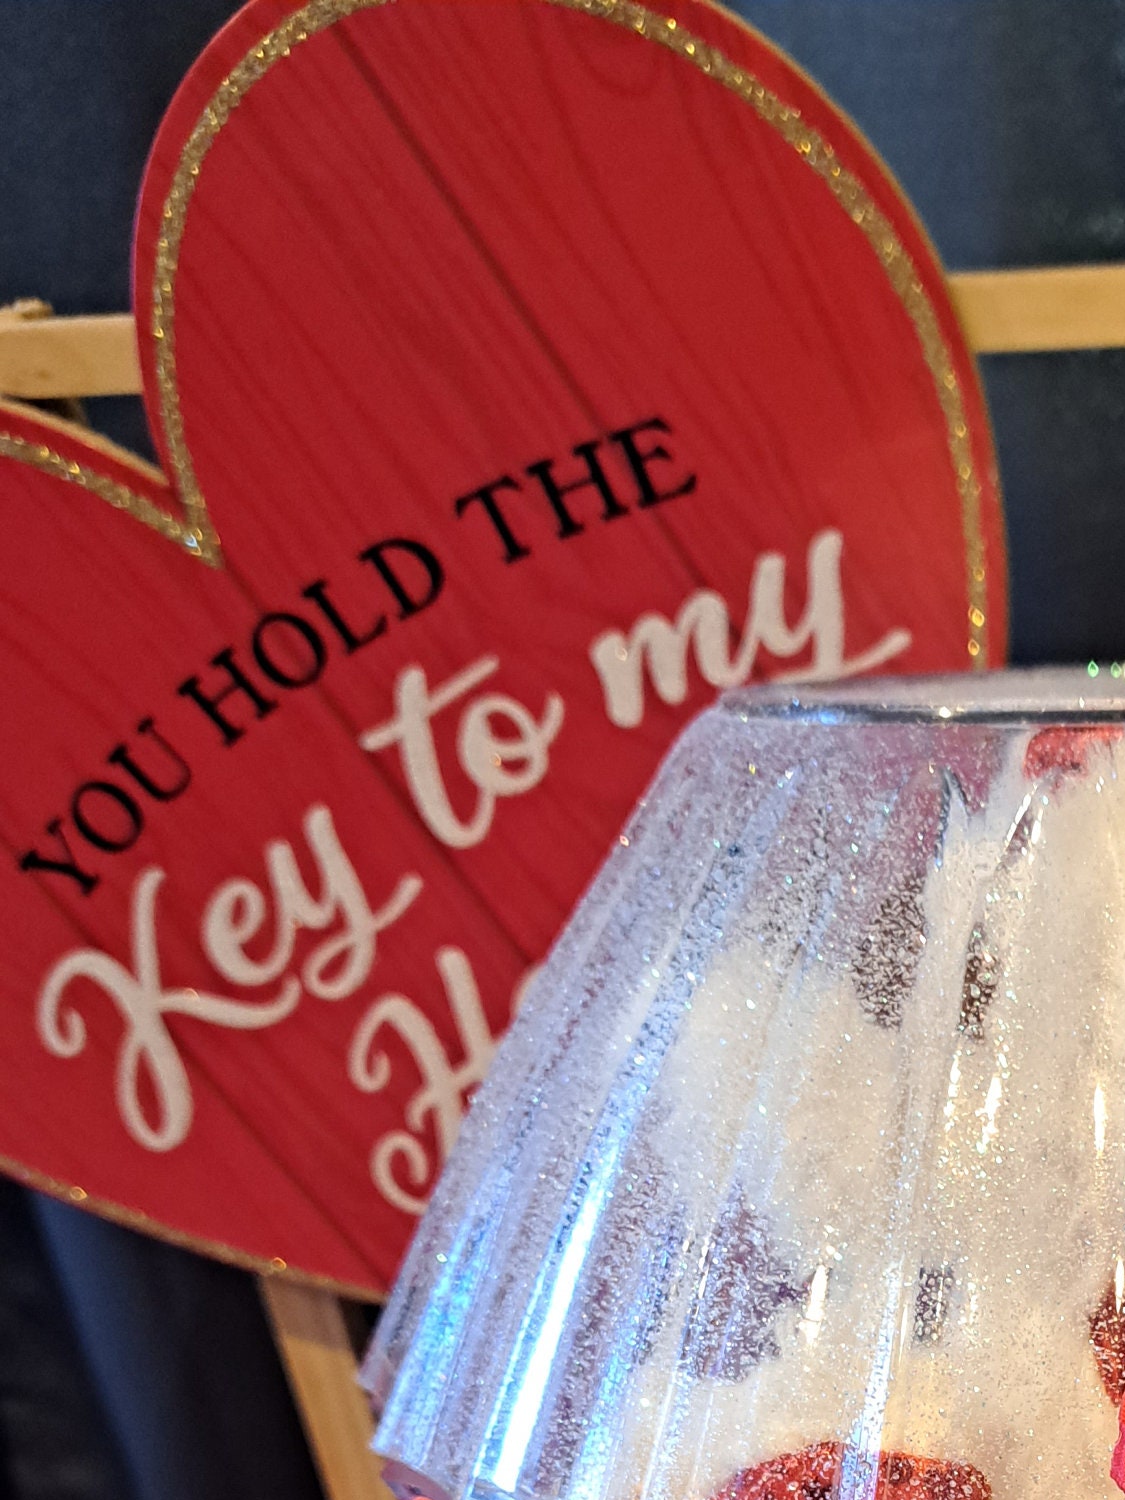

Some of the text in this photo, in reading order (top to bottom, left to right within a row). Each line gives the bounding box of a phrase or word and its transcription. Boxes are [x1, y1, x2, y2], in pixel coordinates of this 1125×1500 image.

[18, 416, 701, 899] YOU HOLD THE
[35, 529, 913, 1153] Key to my
